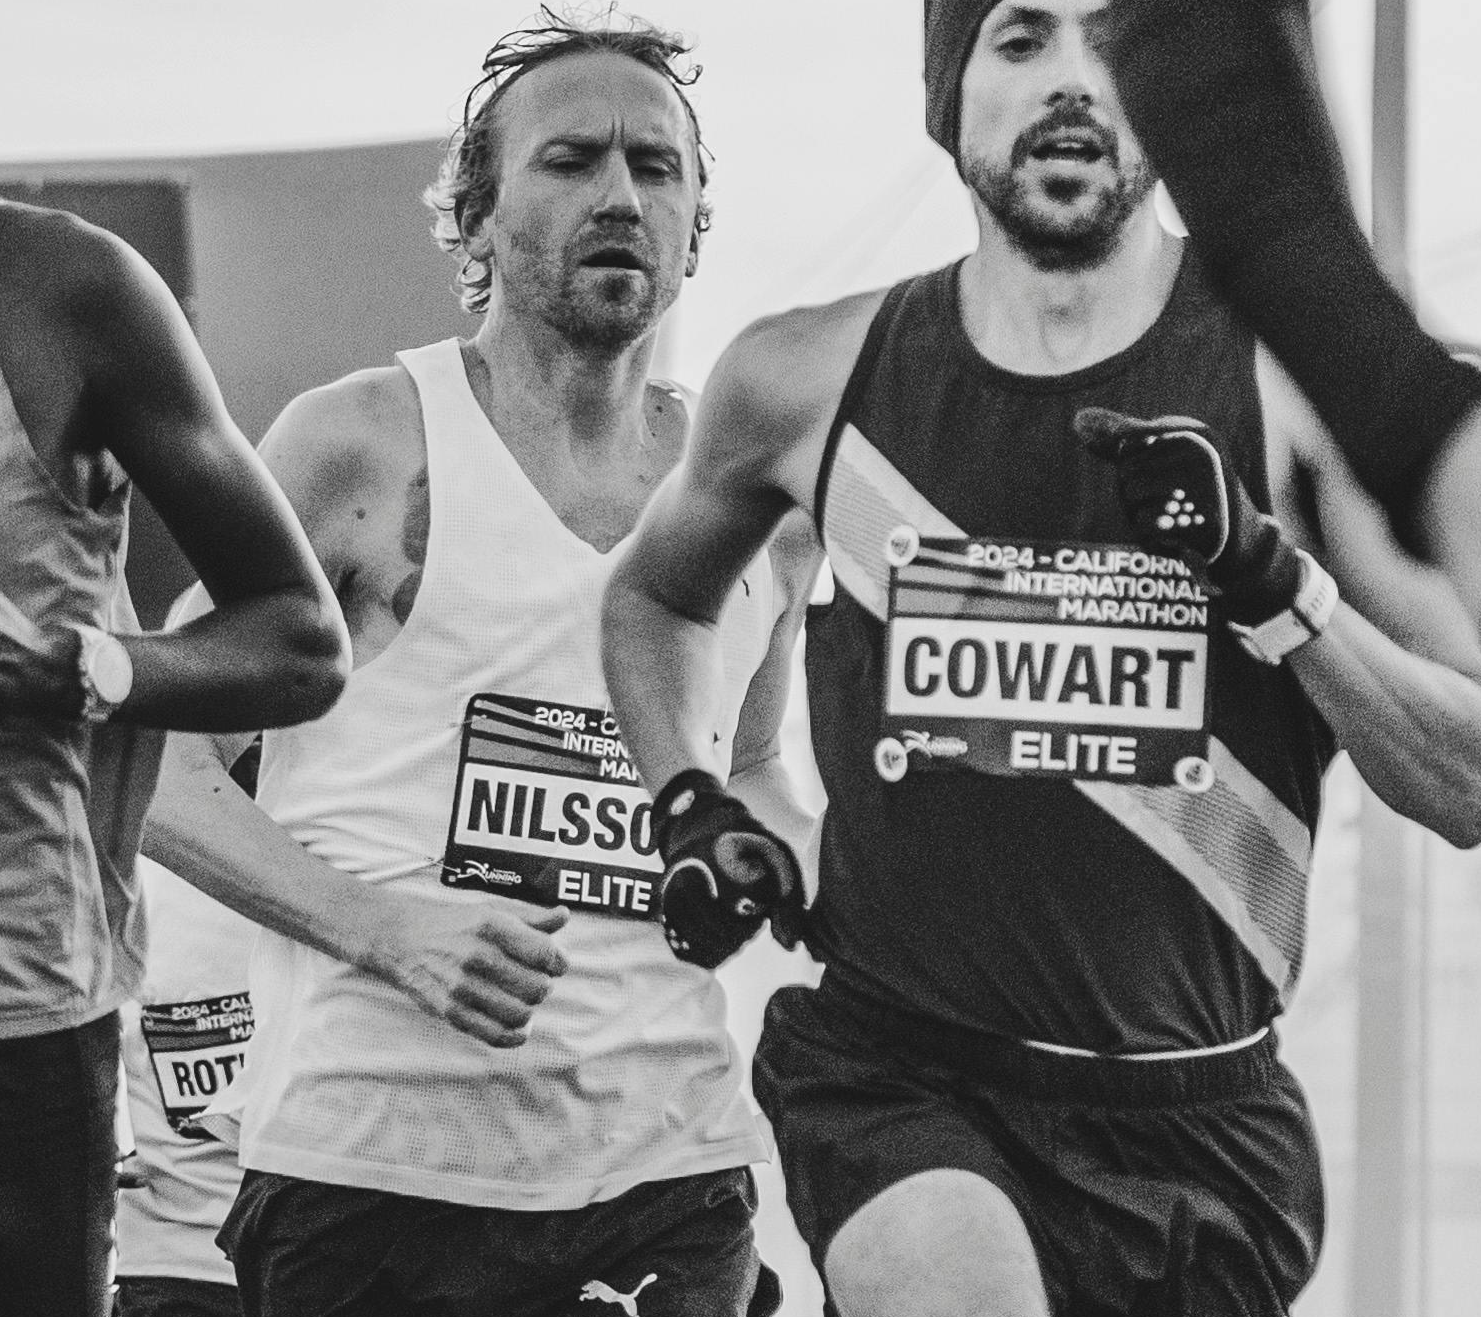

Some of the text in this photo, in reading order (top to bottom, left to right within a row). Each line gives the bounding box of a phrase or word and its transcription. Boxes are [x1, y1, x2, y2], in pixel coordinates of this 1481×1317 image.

[965, 544, 1035, 570] 2024
[1054, 548, 1192, 578] CALIFORN
[1004, 571, 1209, 602] INTERNATIONAL
[1057, 597, 1208, 627] MARATHON
[903, 636, 1196, 710] COWART
[535, 706, 586, 732] 2024
[1010, 730, 1137, 775] ELITE
[467, 779, 659, 857] NILSSO
[557, 869, 652, 912] ELITE
[171, 1003, 210, 1021] 2024
[171, 1053, 245, 1097] ROT
